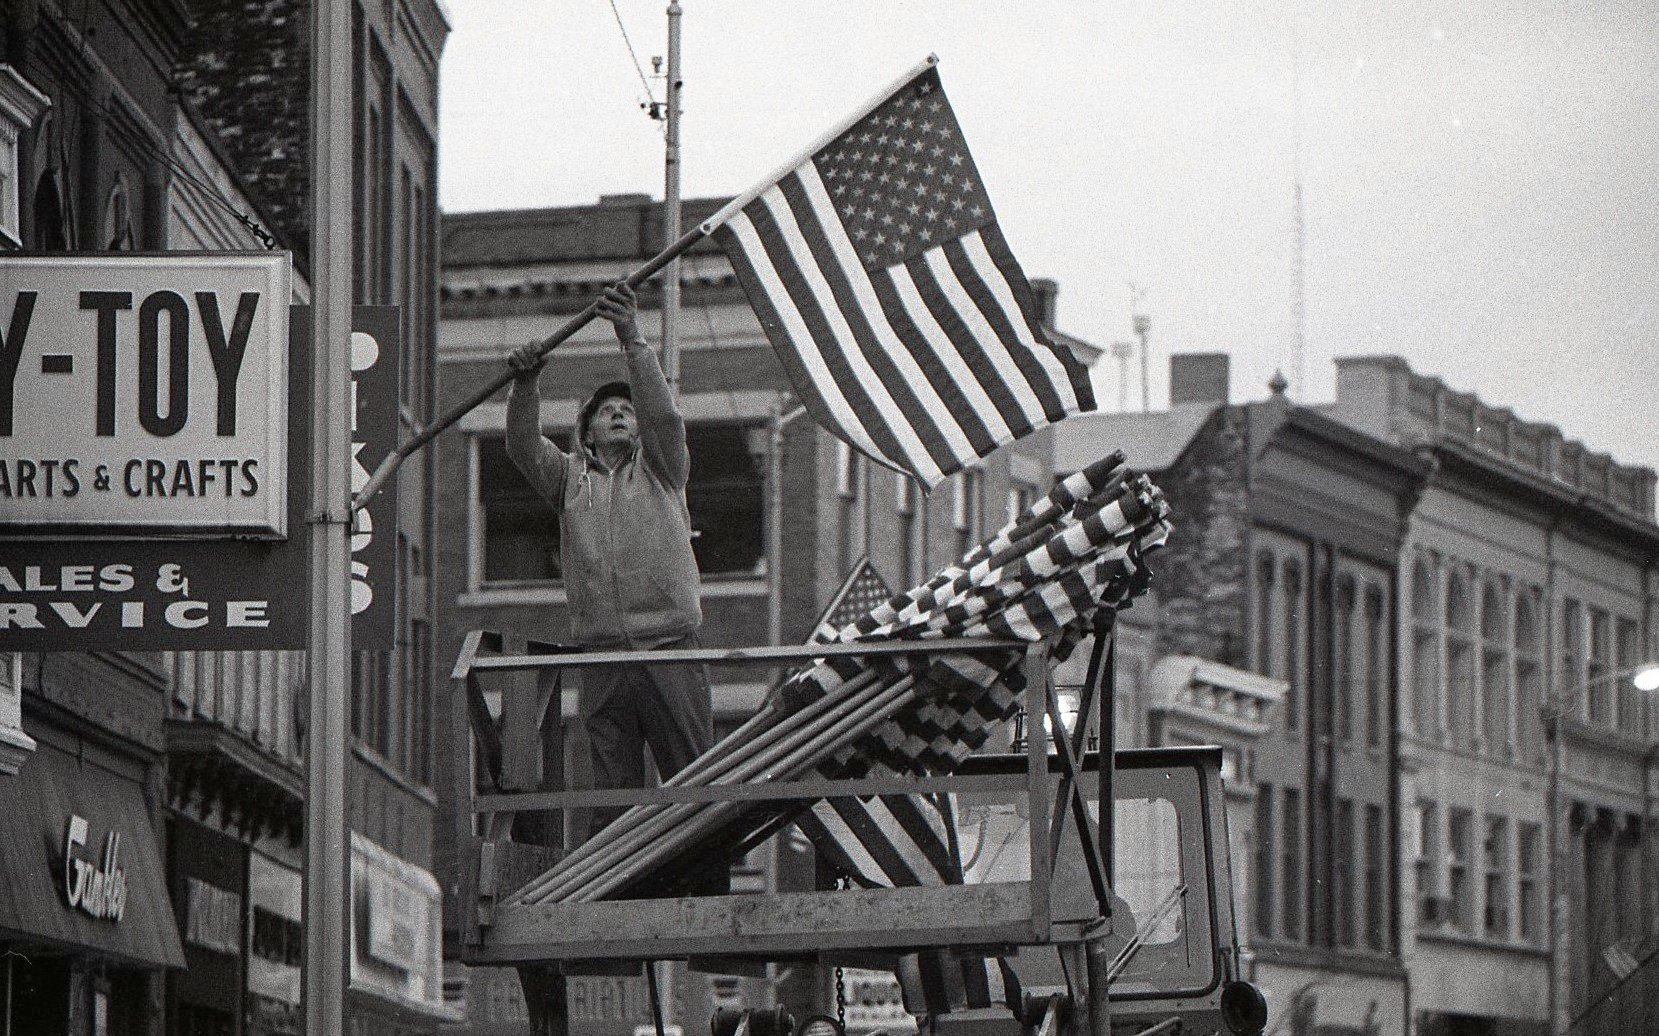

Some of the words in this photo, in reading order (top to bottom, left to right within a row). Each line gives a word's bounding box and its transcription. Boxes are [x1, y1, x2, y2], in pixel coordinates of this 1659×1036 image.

[93, 464, 111, 492] &
[123, 458, 259, 498] CRAFTS
[156, 563, 189, 597] &
